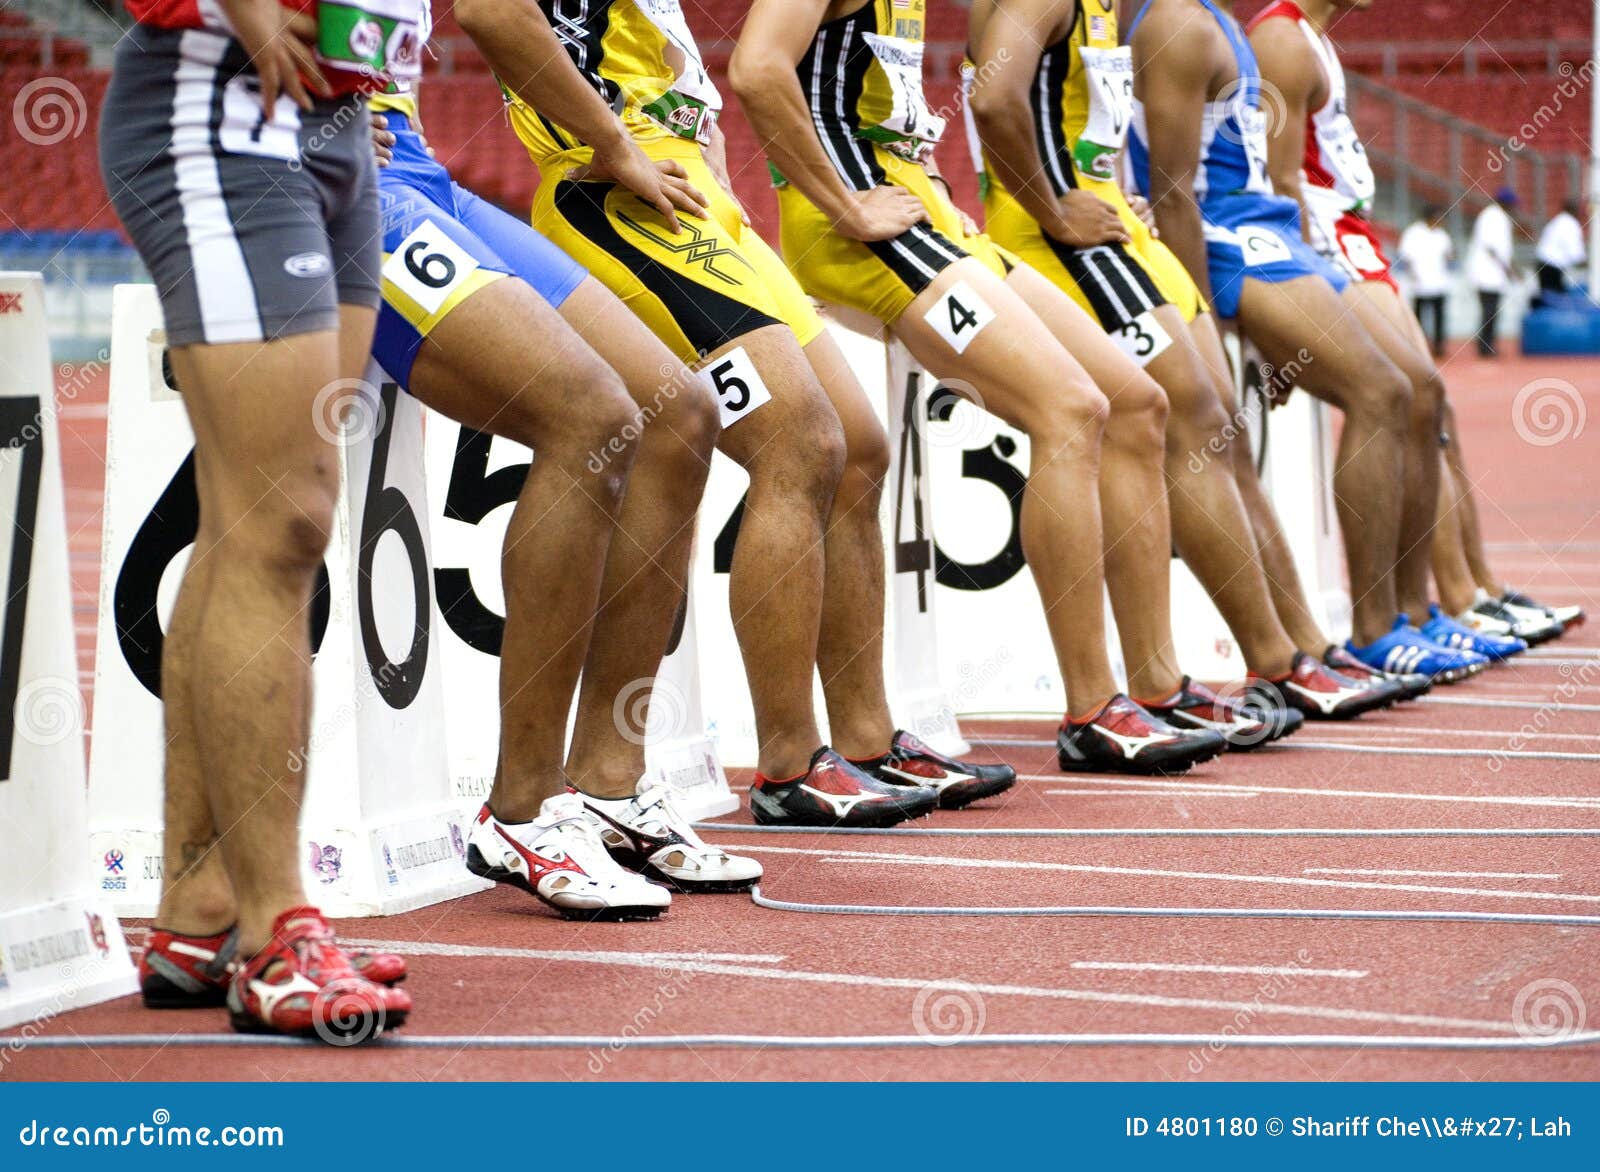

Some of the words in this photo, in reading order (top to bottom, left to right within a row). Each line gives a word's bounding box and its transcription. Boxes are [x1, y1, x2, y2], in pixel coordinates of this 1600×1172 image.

[671, 104, 695, 127] MILO
[404, 241, 456, 289] 6
[948, 295, 977, 336] 4
[1121, 321, 1155, 357] 3
[710, 360, 751, 412] 5
[895, 372, 933, 613] 4
[358, 380, 431, 710] 6
